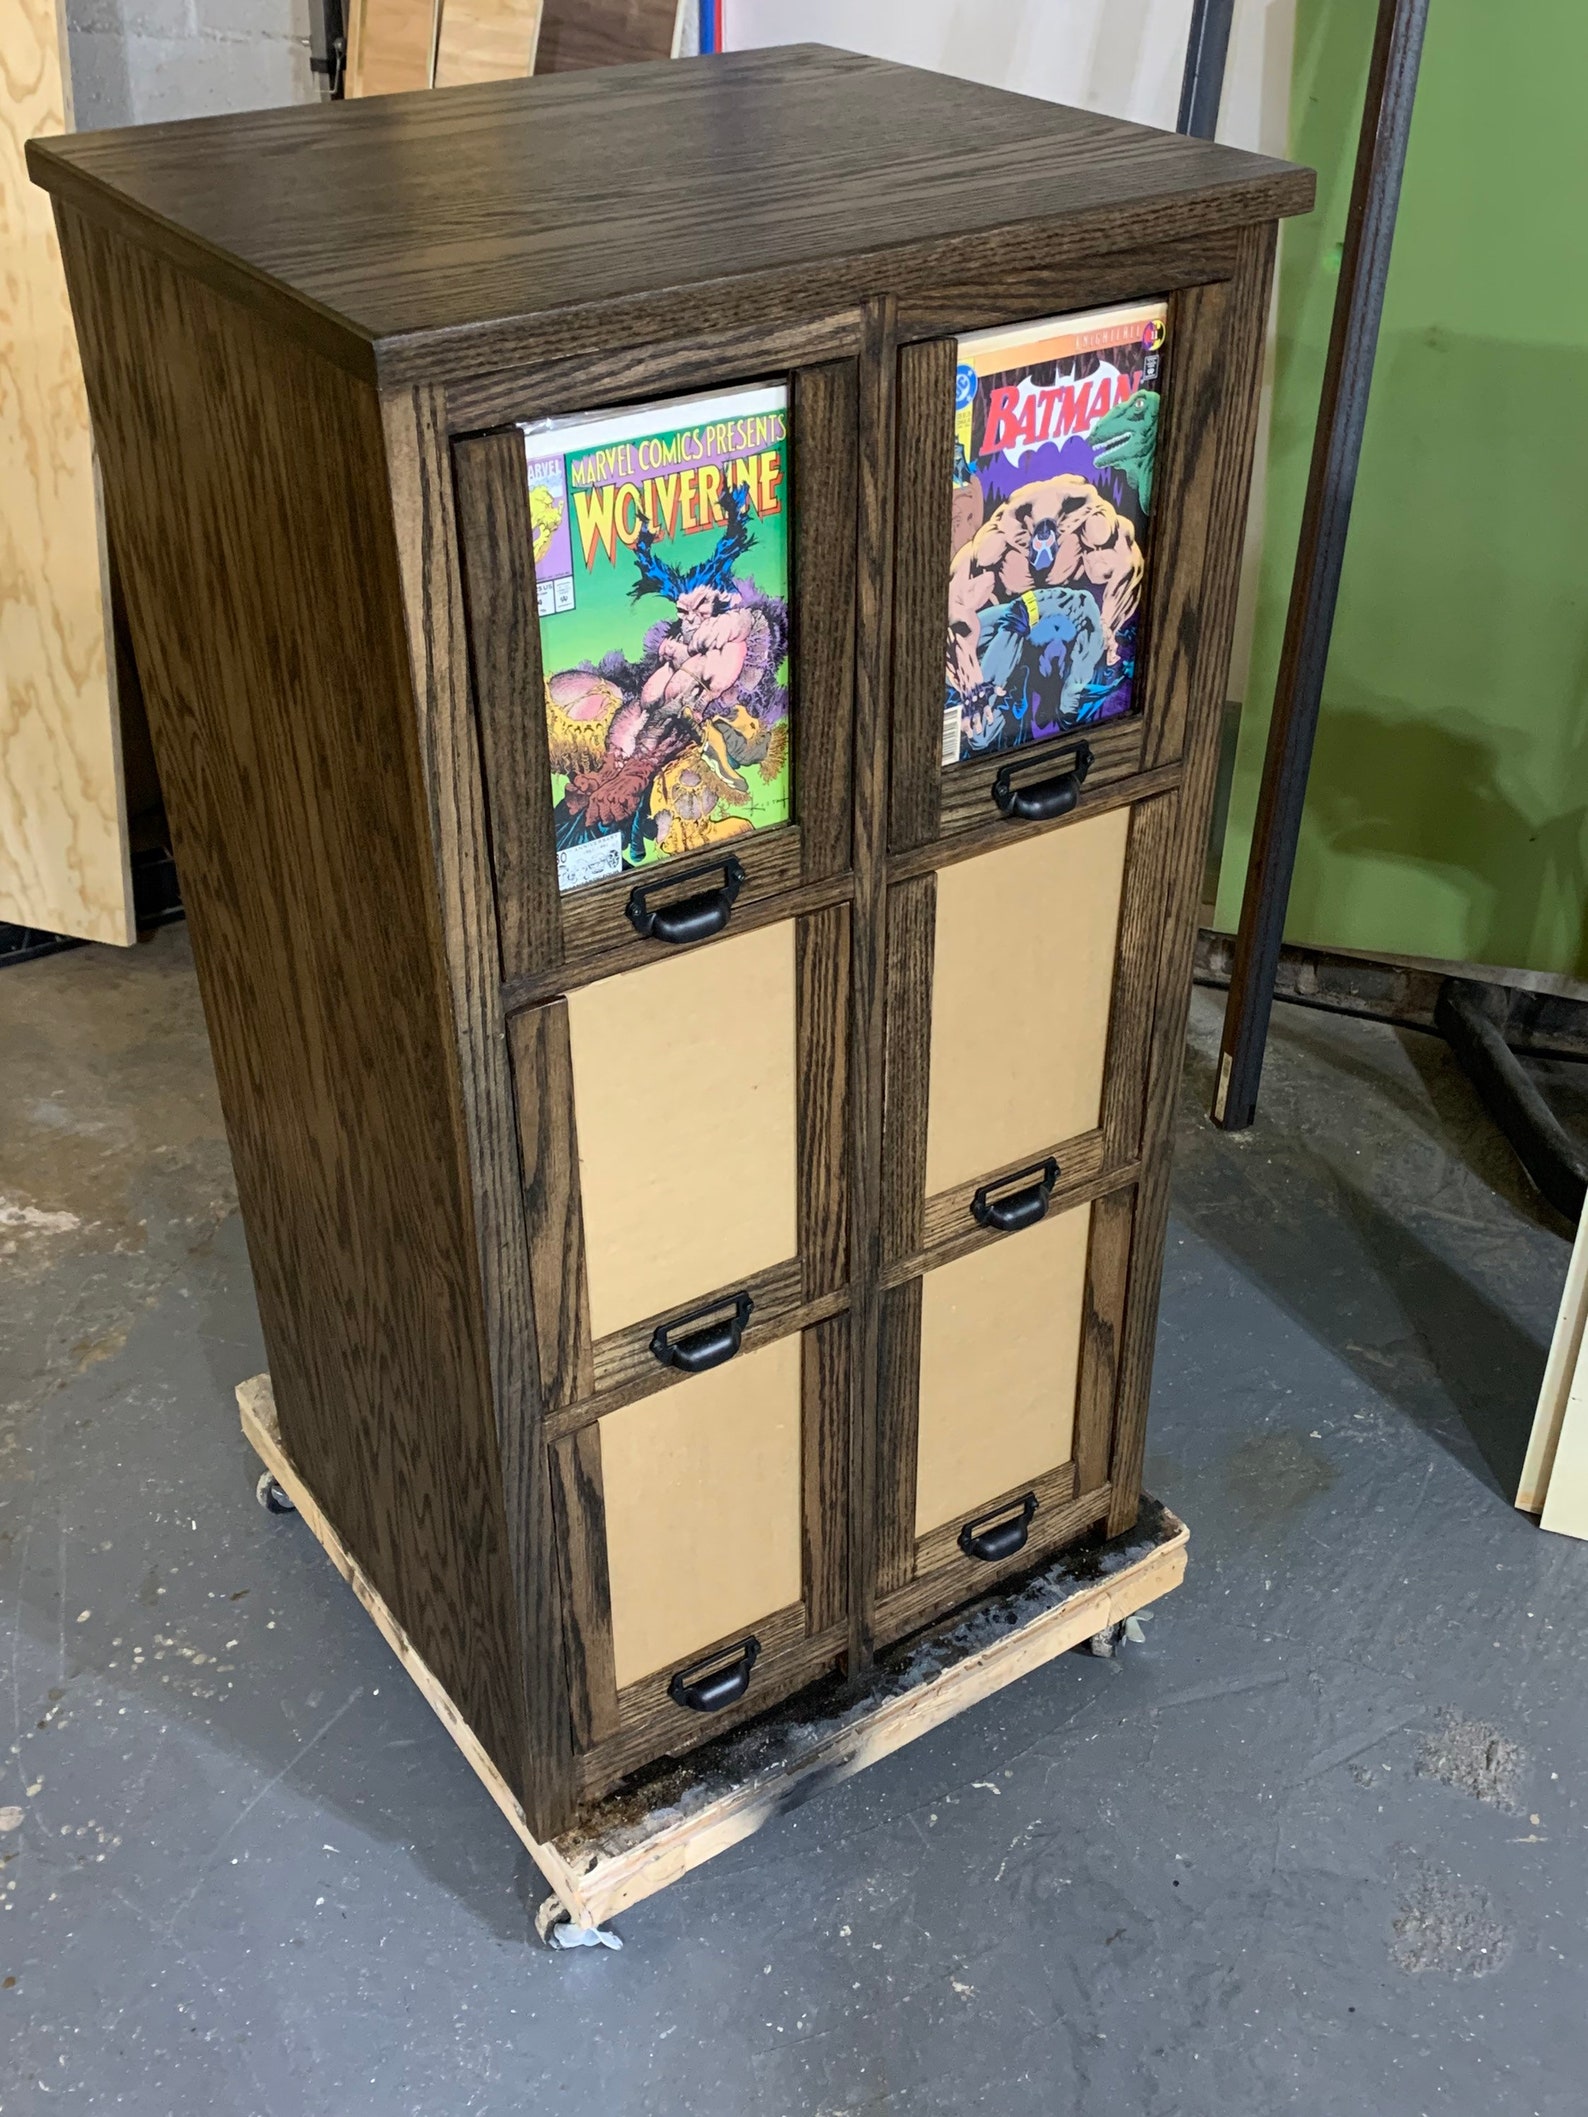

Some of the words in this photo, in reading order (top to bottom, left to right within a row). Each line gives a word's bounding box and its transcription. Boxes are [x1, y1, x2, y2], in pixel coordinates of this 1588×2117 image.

[571, 443, 635, 487] MARVEL
[638, 428, 704, 471] COMICS
[706, 413, 787, 457] PRESENTS
[979, 371, 1143, 456] BATMAN
[528, 459, 561, 480] ARVEL
